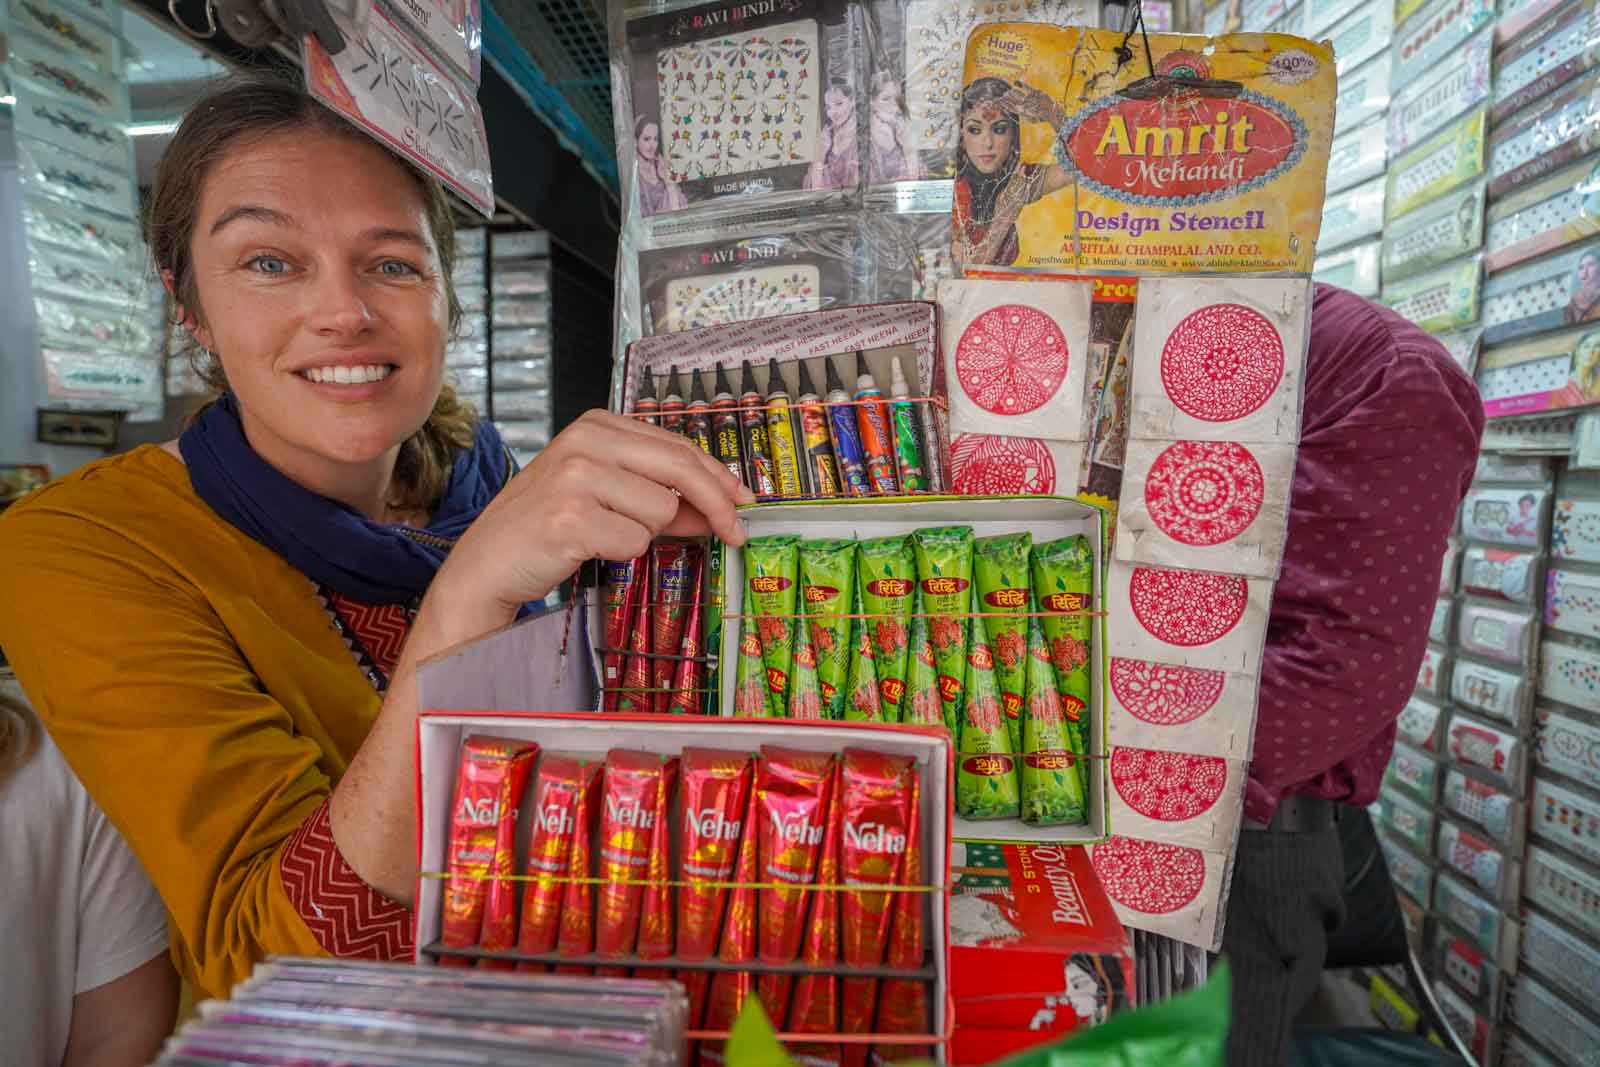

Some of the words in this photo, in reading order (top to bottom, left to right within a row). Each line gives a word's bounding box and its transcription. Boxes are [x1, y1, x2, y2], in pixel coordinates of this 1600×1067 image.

[692, 10, 728, 29] RAVI
[987, 35, 1025, 52] Huge
[1093, 111, 1254, 157] Amrit
[1123, 156, 1246, 189] Mehandi
[713, 182, 737, 193] MADE
[1077, 210, 1161, 238] Design
[1168, 210, 1265, 232] Stencil
[1125, 243, 1202, 257] CHAMPALAL
[1206, 243, 1235, 256] AND
[1238, 243, 1263, 256] CO.
[807, 340, 831, 356] FAST
[843, 338, 866, 353] FAST
[867, 325, 899, 345] HEENA
[532, 803, 575, 835] Neh
[684, 806, 742, 841] Neha
[769, 808, 824, 846] Neha
[843, 821, 907, 854] Neha
[1027, 884, 1041, 893] 3
[1043, 865, 1087, 926] Beauty
